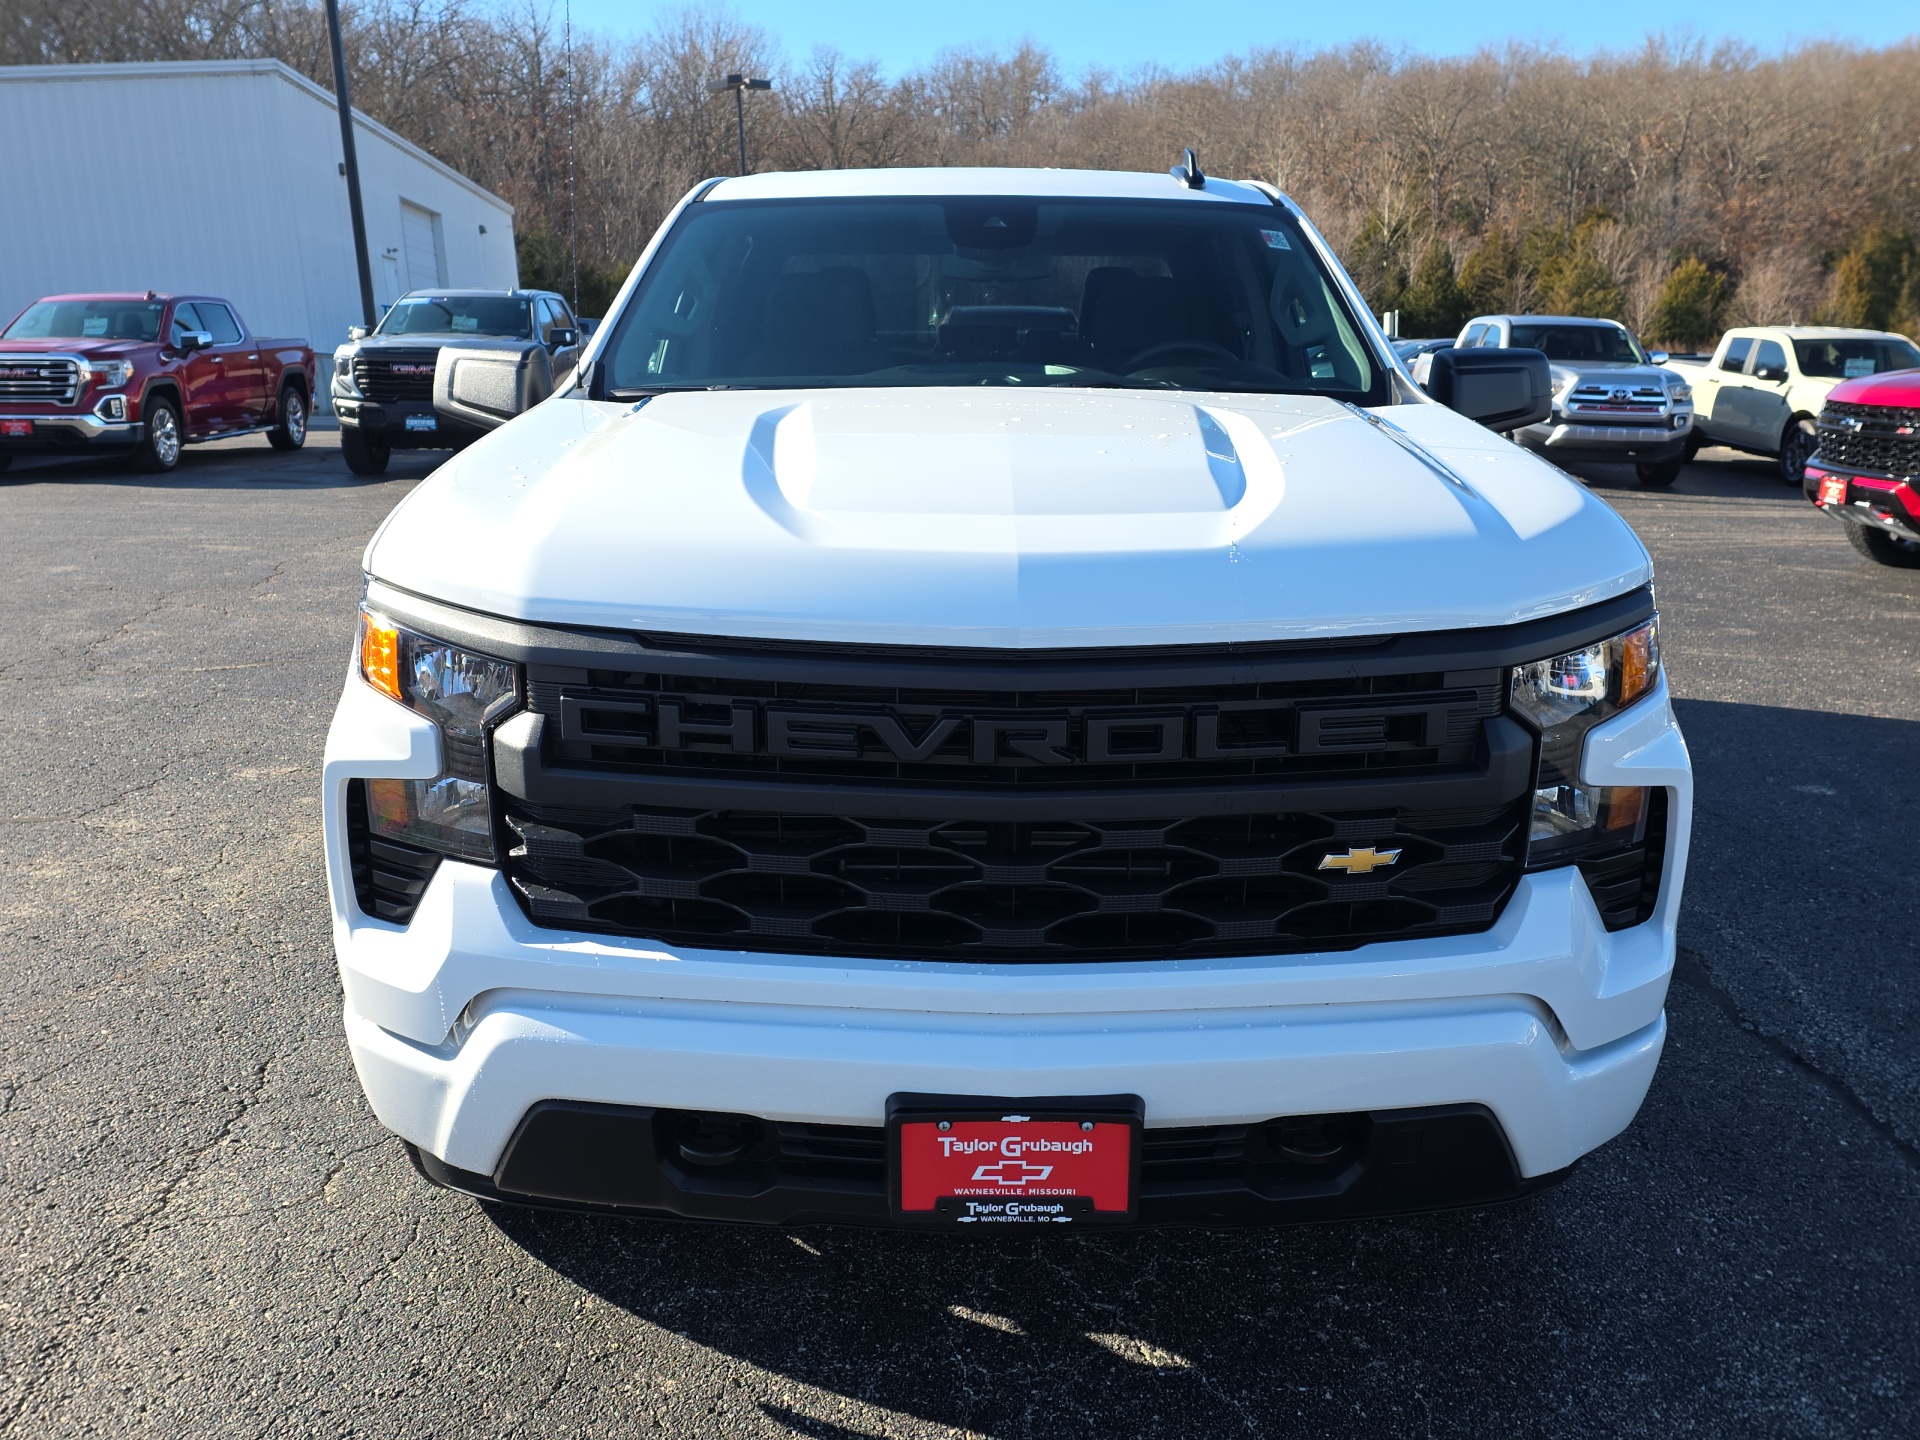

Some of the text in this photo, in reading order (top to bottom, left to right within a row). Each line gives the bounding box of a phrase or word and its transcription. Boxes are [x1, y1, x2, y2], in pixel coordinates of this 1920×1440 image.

[0, 367, 38, 379] MC
[392, 364, 436, 375] GMC
[559, 692, 1480, 765] CHEVROLET
[937, 1136, 1093, 1157] Taylor Grubaugh
[953, 1188, 1077, 1196] WAYNESVILLE, MISSOURI
[965, 1202, 1064, 1216] Taylor Grubaugh
